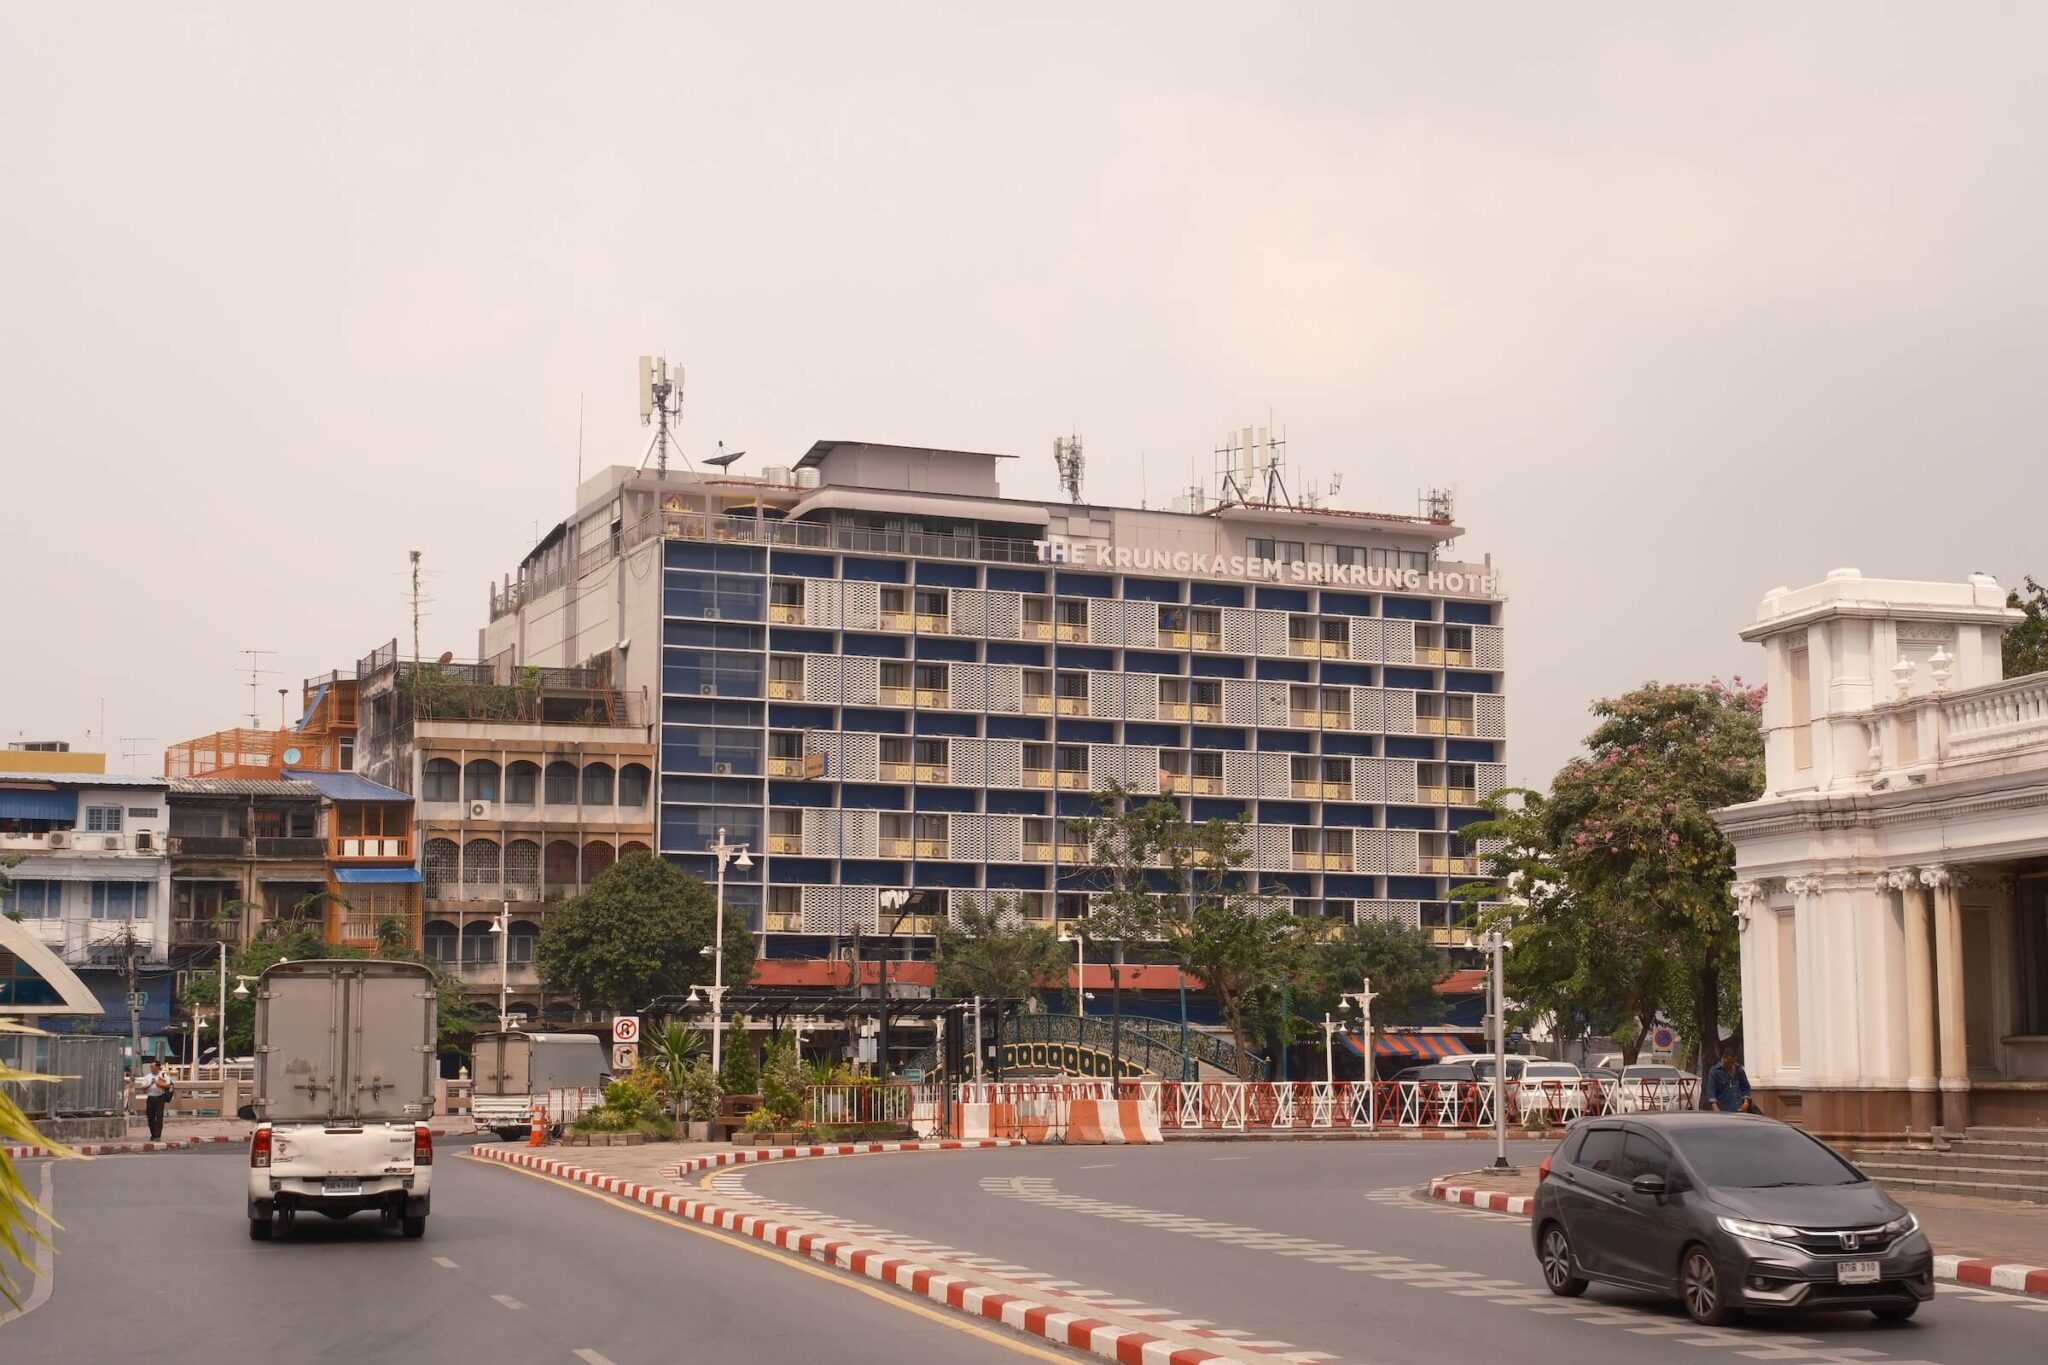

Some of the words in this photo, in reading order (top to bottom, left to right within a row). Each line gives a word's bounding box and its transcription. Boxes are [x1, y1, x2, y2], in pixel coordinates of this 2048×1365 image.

[1033, 539, 1087, 564] THE
[1096, 546, 1283, 581] KRUNGKASEM
[1290, 560, 1421, 589] SRIKRUNG
